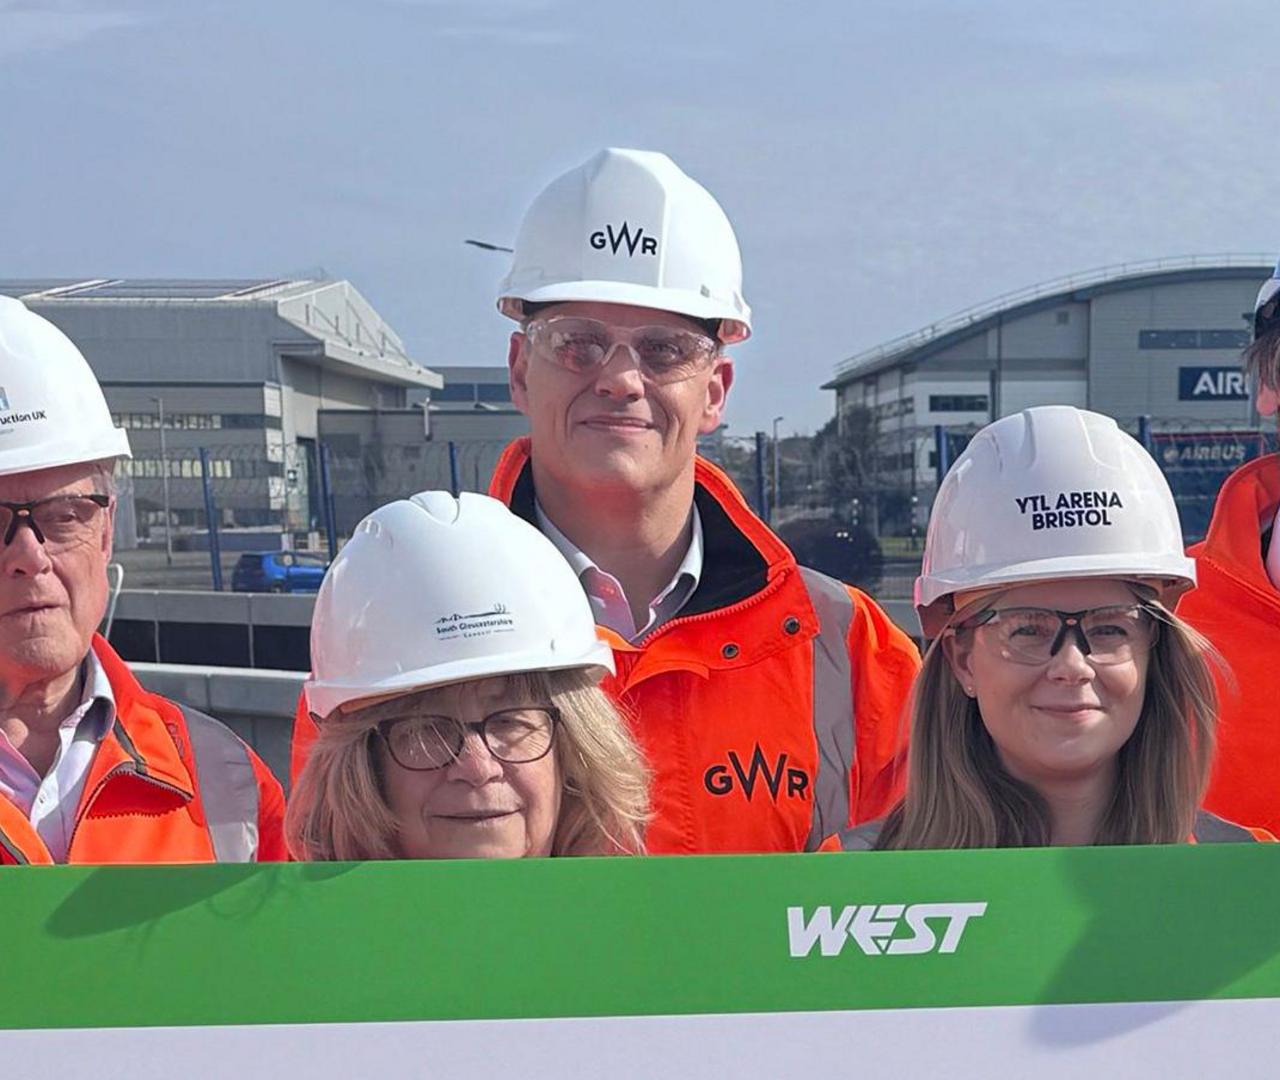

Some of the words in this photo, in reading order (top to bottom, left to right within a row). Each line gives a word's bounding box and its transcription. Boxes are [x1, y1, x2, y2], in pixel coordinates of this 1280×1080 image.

[590, 221, 658, 257] GWR
[1193, 371, 1250, 395] AIR
[1180, 445, 1246, 460] AIRBUS
[1015, 495, 1051, 514] YTL
[1055, 491, 1123, 510] ARENA
[1032, 509, 1112, 530] BRISTOL
[704, 742, 809, 804] GWR
[786, 901, 988, 957] WEST
